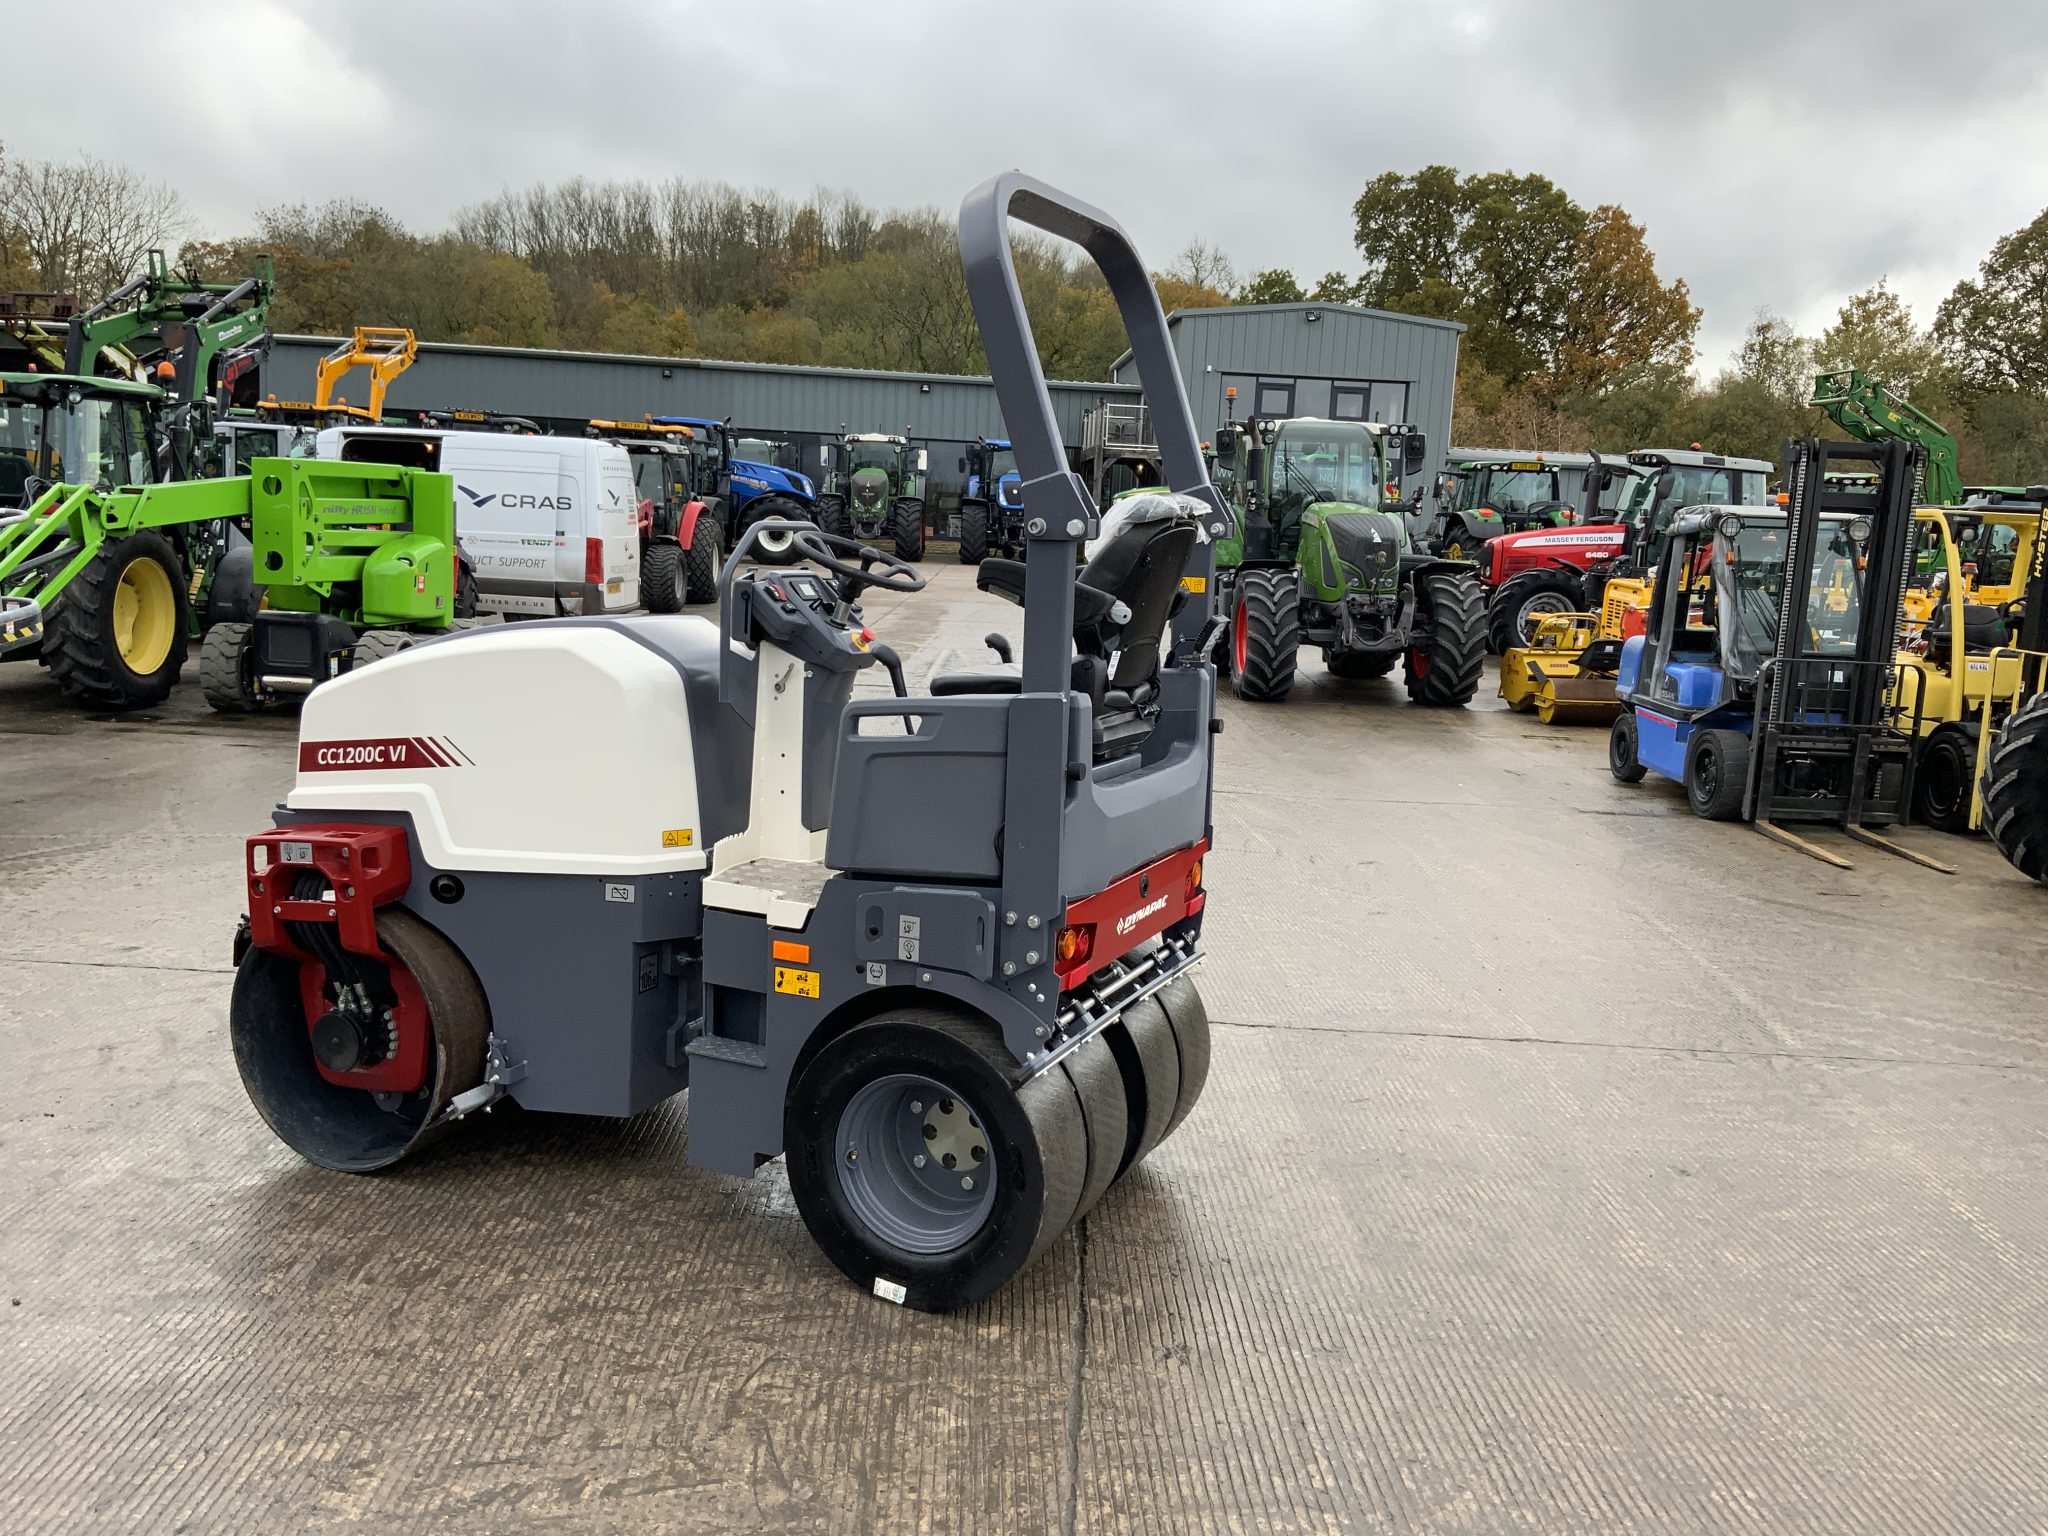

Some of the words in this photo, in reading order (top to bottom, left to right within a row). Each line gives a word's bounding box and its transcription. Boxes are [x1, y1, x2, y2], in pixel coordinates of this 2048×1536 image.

[521, 538, 552, 547] FENDT
[1576, 534, 1614, 542] FERGUSON
[1585, 551, 1609, 559] 6480
[498, 556, 547, 569] SUPPORT
[317, 745, 386, 765] CC1200C
[389, 744, 407, 762] VI
[1124, 894, 1168, 929] DYNAPAC
